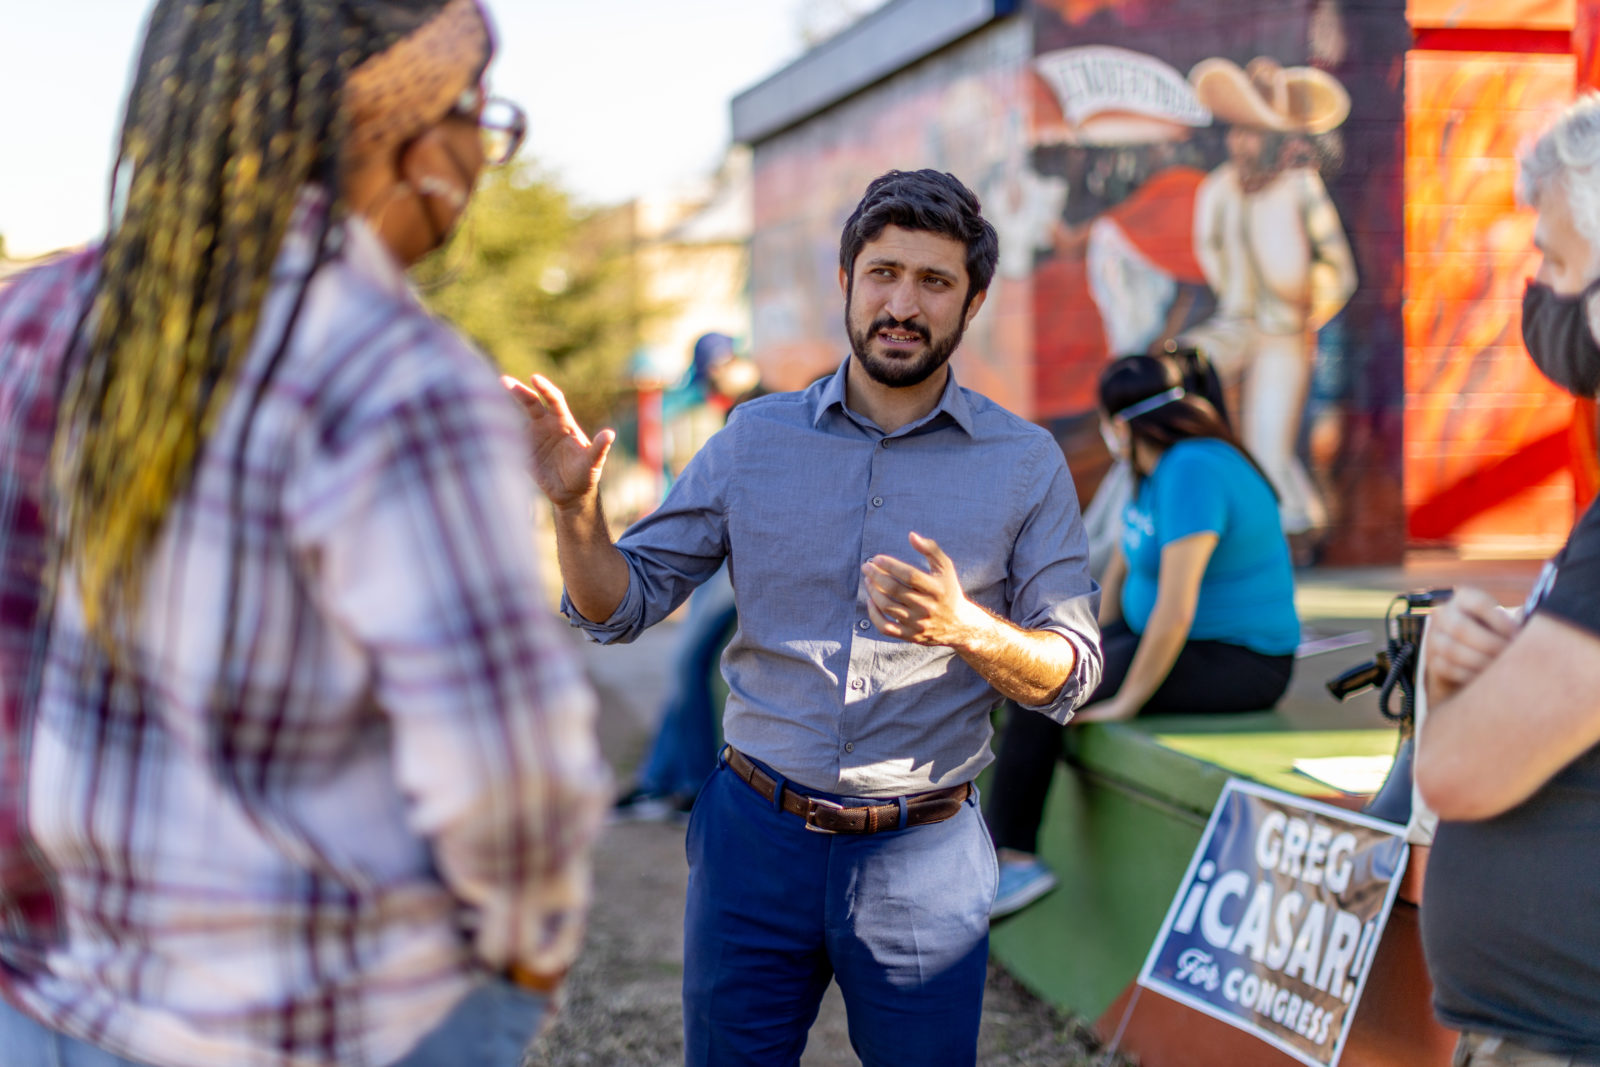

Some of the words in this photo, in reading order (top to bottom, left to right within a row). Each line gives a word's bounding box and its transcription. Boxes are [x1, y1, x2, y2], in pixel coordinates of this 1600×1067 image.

[1256, 812, 1356, 893] GREG
[1173, 861, 1375, 1003] ¡CASAR!
[1177, 948, 1220, 991] For
[1222, 967, 1333, 1045] CONGRESS
